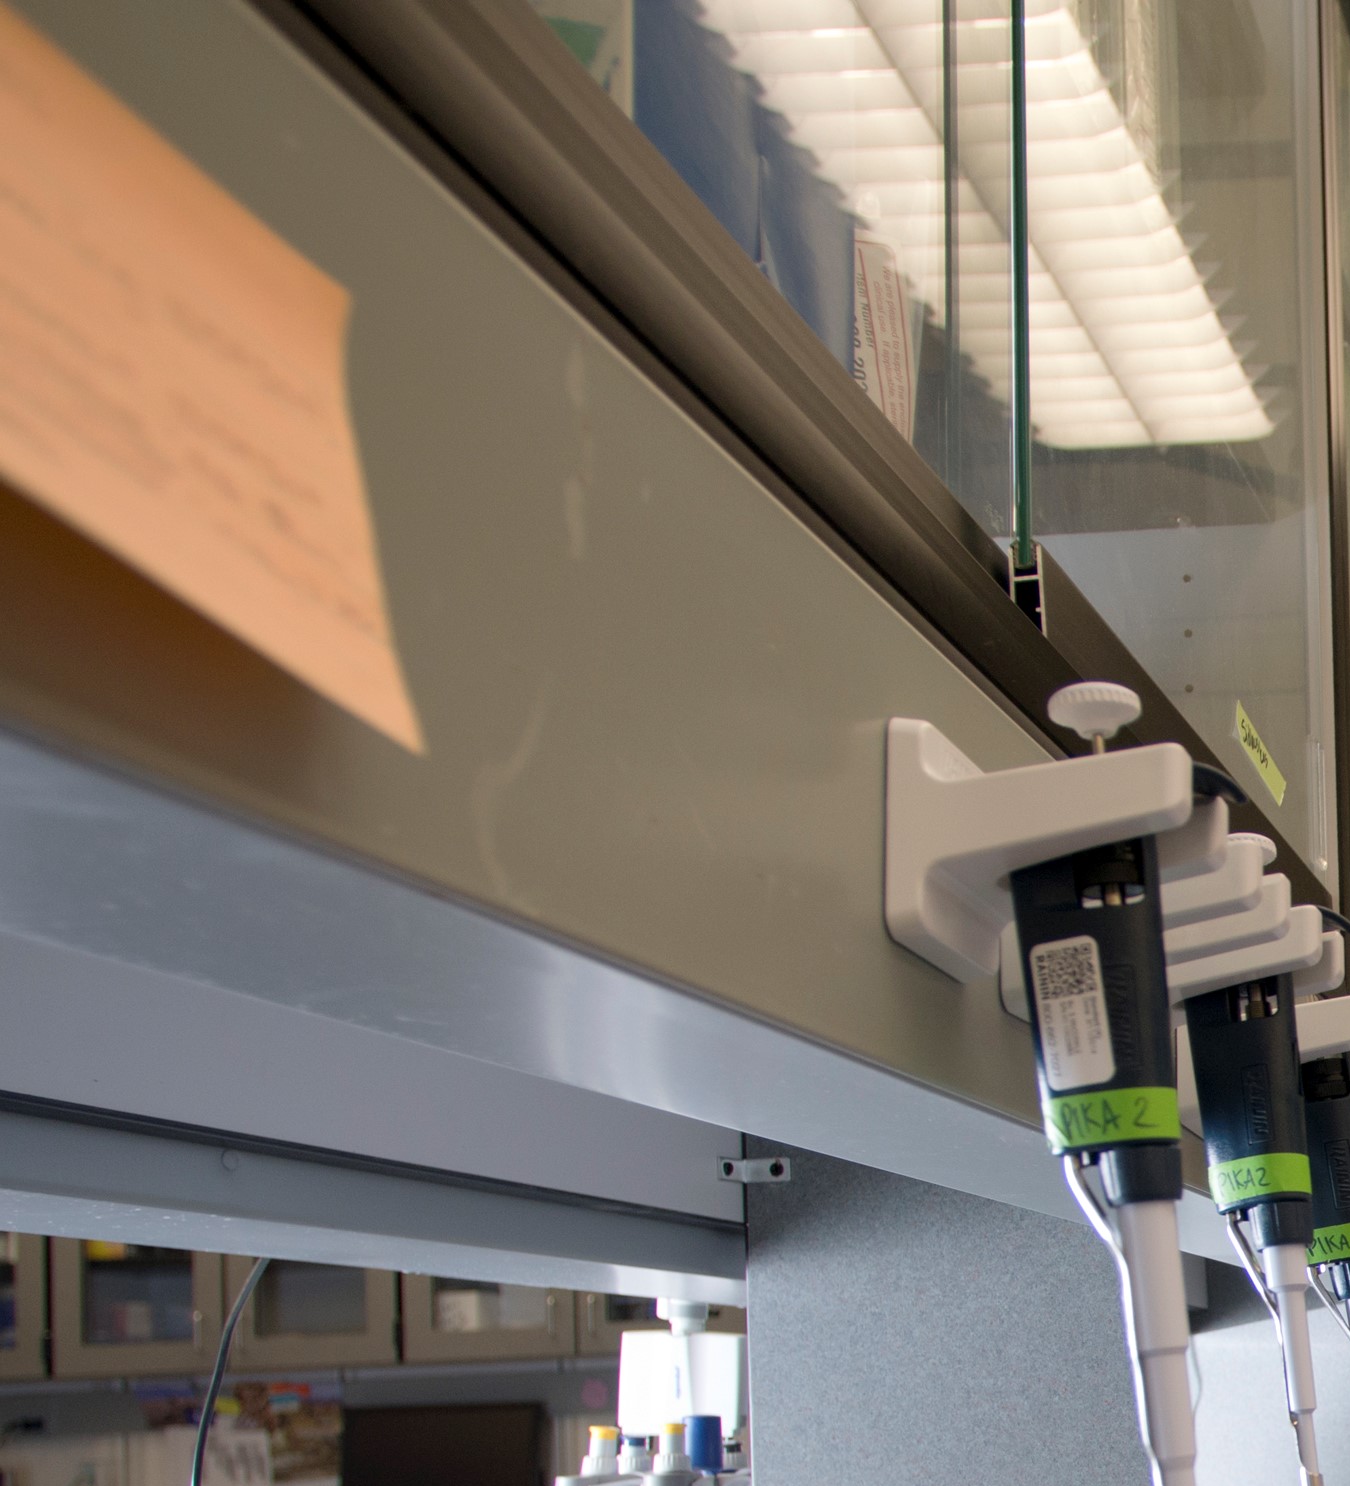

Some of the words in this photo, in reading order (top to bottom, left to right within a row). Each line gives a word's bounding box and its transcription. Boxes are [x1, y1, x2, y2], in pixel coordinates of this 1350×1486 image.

[885, 299, 900, 339] pleased
[1036, 954, 1052, 998] RAININ
[1059, 1100, 1121, 1141] PIKA
[1132, 1096, 1158, 1129] 2
[1308, 1232, 1349, 1258] PIKA
